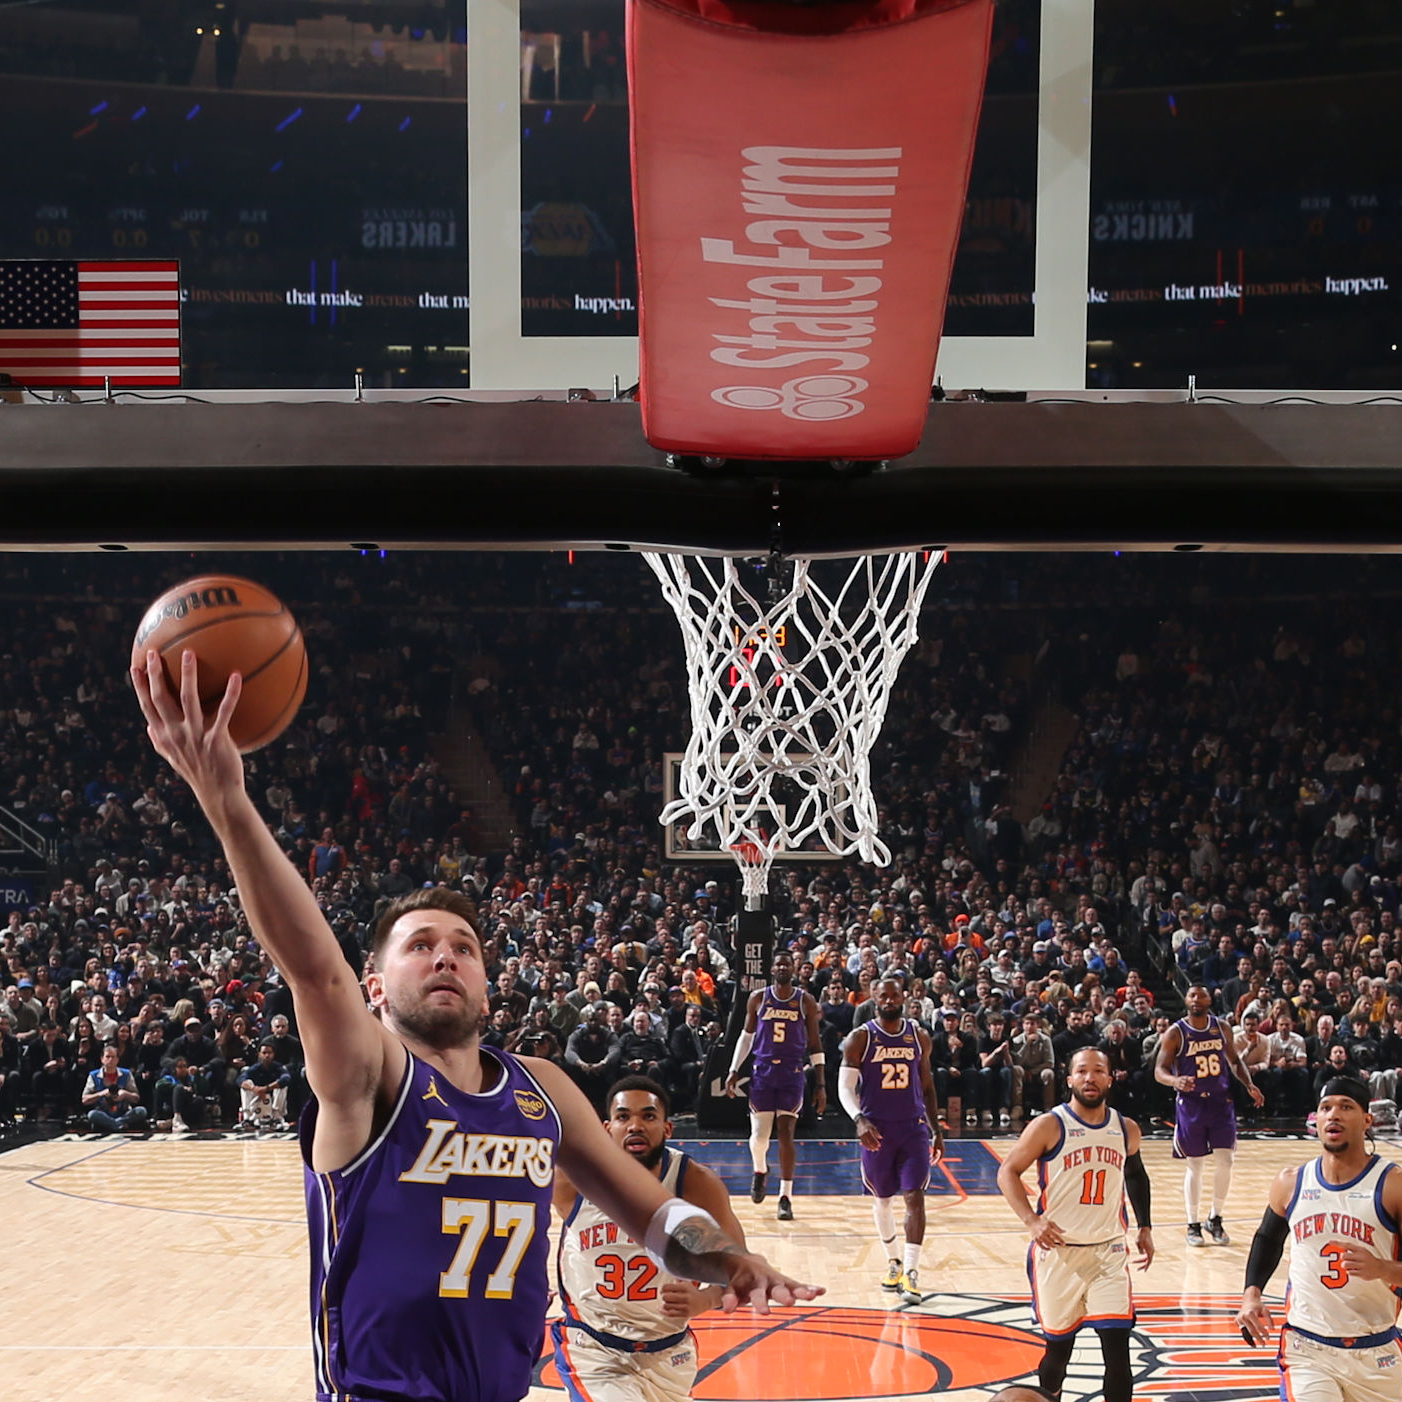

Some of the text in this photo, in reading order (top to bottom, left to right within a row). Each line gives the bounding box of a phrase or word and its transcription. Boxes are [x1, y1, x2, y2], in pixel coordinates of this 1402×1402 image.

[191, 287, 284, 305] investments
[286, 287, 317, 306] that
[321, 288, 364, 306] make
[365, 291, 415, 308] arenas
[418, 290, 448, 308] that
[1088, 274, 1389, 305] ke arenas that make memories happen.
[522, 293, 635, 314] mories happen.
[744, 943, 763, 959] GET
[745, 959, 763, 975] THE
[760, 1006, 799, 1022] LAKERS
[772, 1022, 786, 1043] 5
[870, 1045, 915, 1063] LAKERS
[1185, 1039, 1224, 1057] LAKERS
[881, 1063, 910, 1090] 23
[1194, 1053, 1222, 1079] 36
[397, 1118, 556, 1189] LAKERS
[1063, 1148, 1093, 1172] NEW
[1080, 1168, 1107, 1206] 11
[579, 1222, 620, 1252] NEW
[1293, 1212, 1376, 1247] NEW YORK
[438, 1196, 536, 1300] 77
[595, 1254, 660, 1302] 32
[1319, 1241, 1350, 1290] 3
